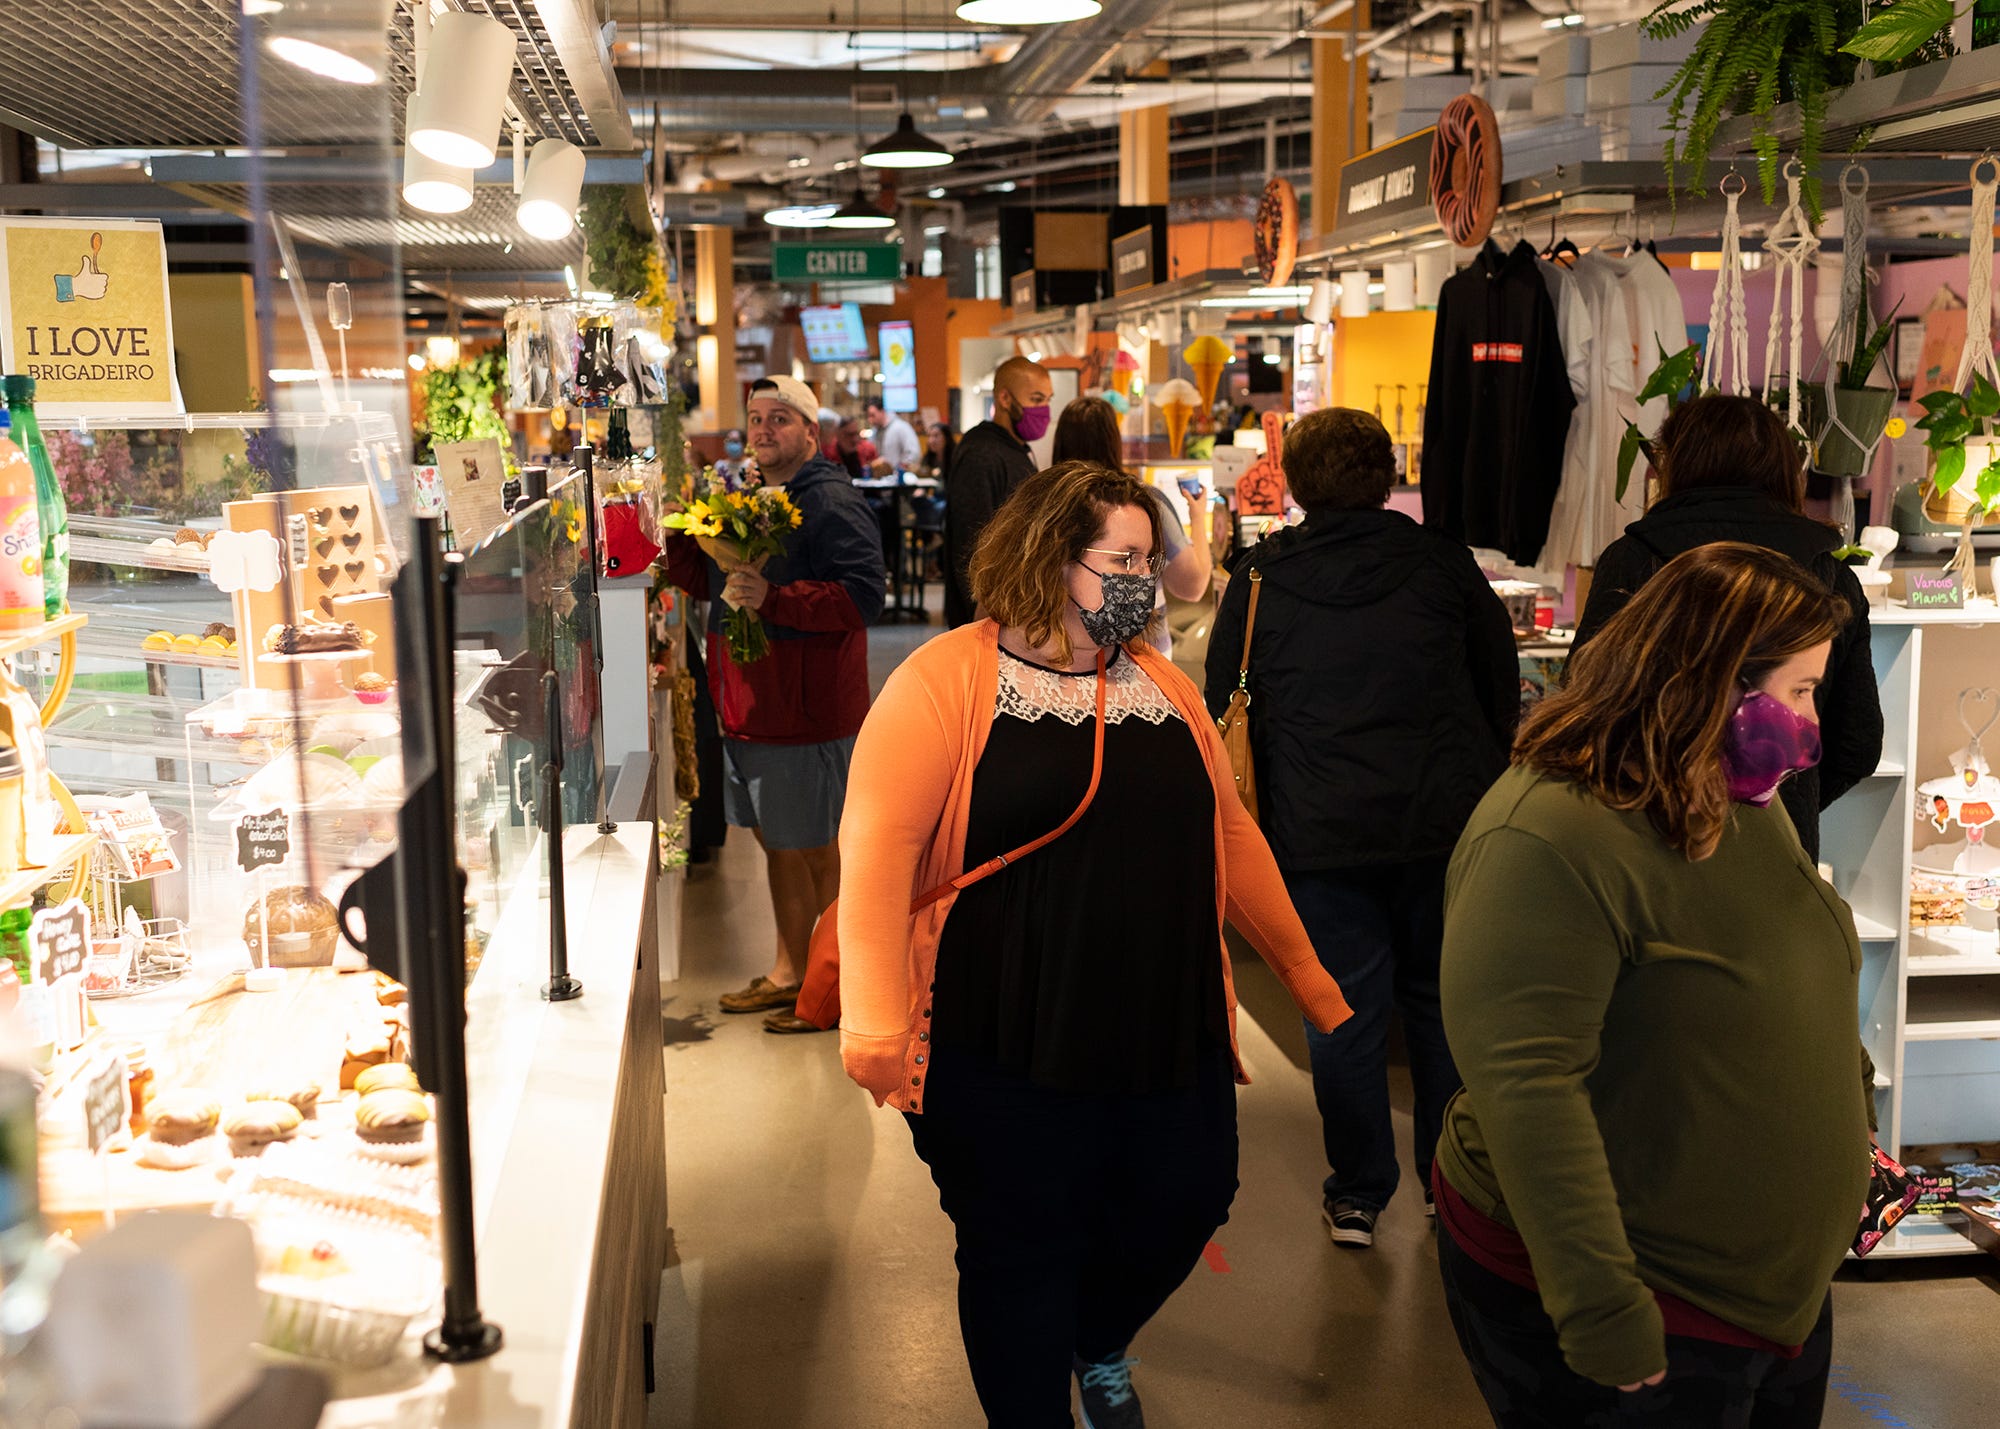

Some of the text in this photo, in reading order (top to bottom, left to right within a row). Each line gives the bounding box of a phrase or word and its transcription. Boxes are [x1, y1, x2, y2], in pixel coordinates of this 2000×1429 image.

[806, 250, 867, 274] CENTER
[26, 326, 150, 357] I LOVE
[27, 364, 154, 381] BRIGADEIRO
[1912, 573, 1954, 589] Various
[1912, 591, 1948, 605] Plants
